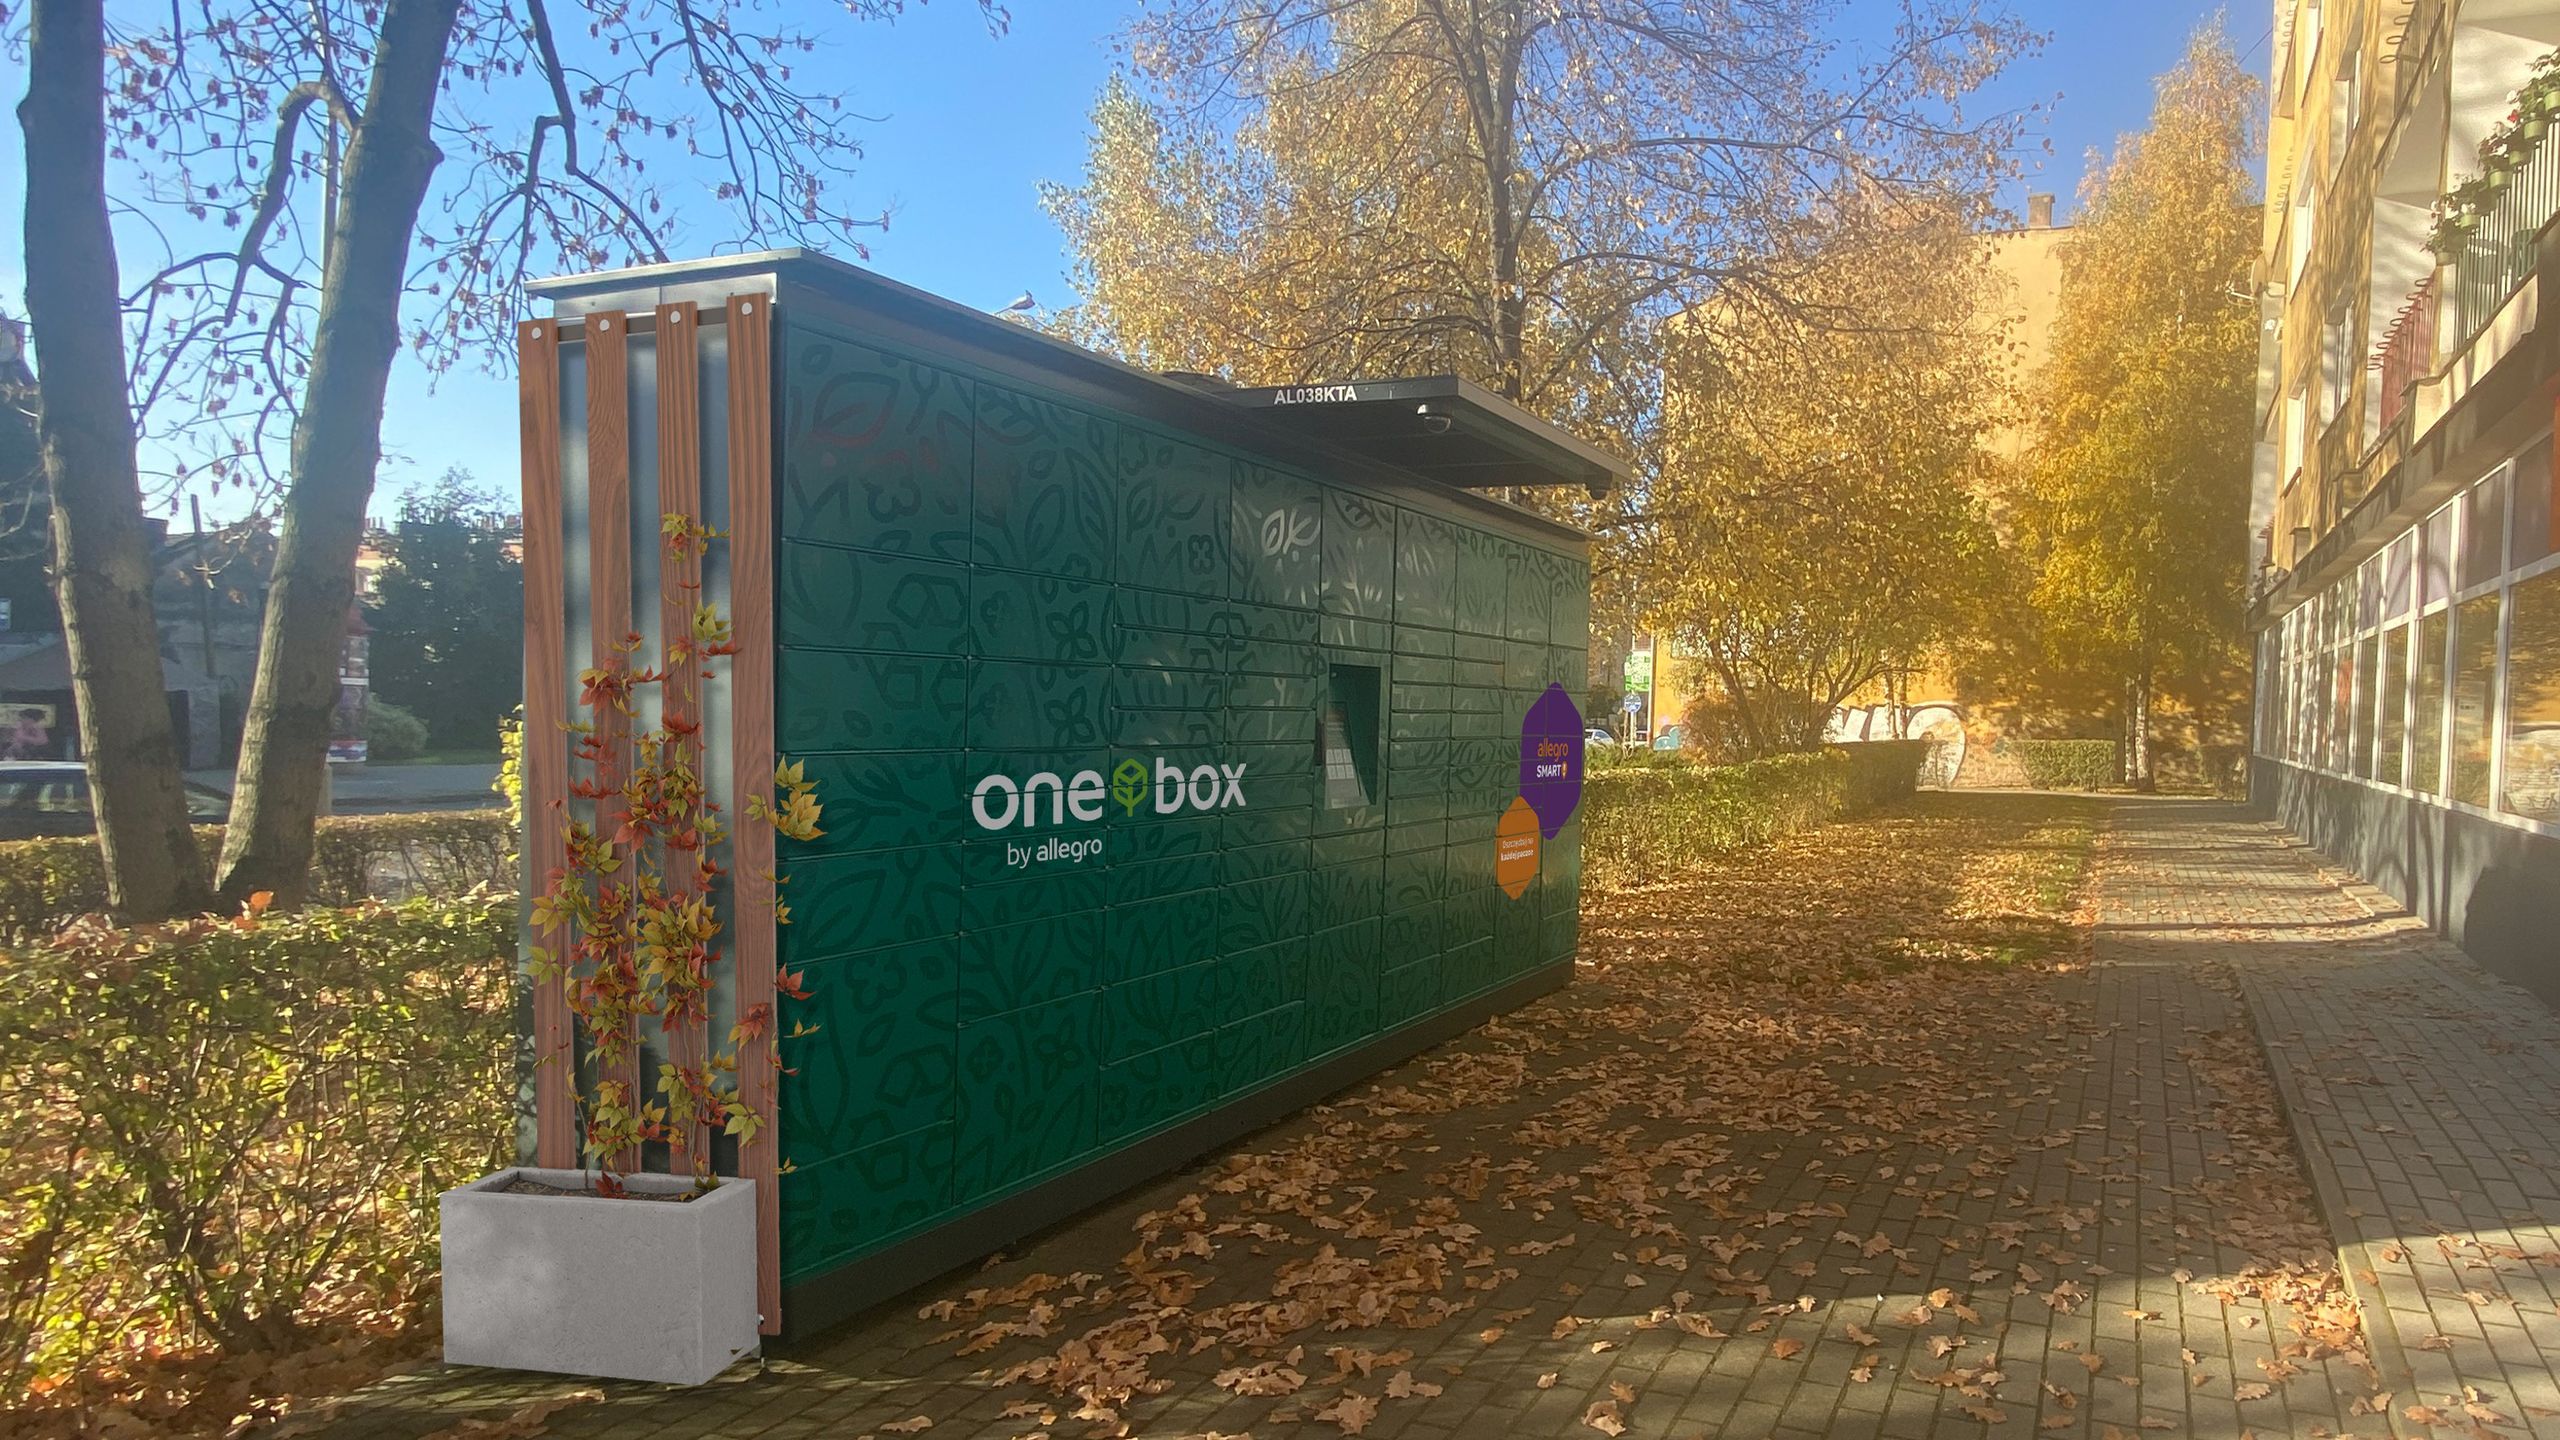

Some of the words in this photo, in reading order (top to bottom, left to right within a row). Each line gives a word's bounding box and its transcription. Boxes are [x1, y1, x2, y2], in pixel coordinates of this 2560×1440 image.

[1274, 385, 1357, 405] AL038KTA
[1537, 737, 1568, 762] allegro
[972, 770, 1105, 830] one
[1155, 757, 1247, 814] box
[1007, 843, 1031, 869] by
[1036, 838, 1102, 863] allegro
